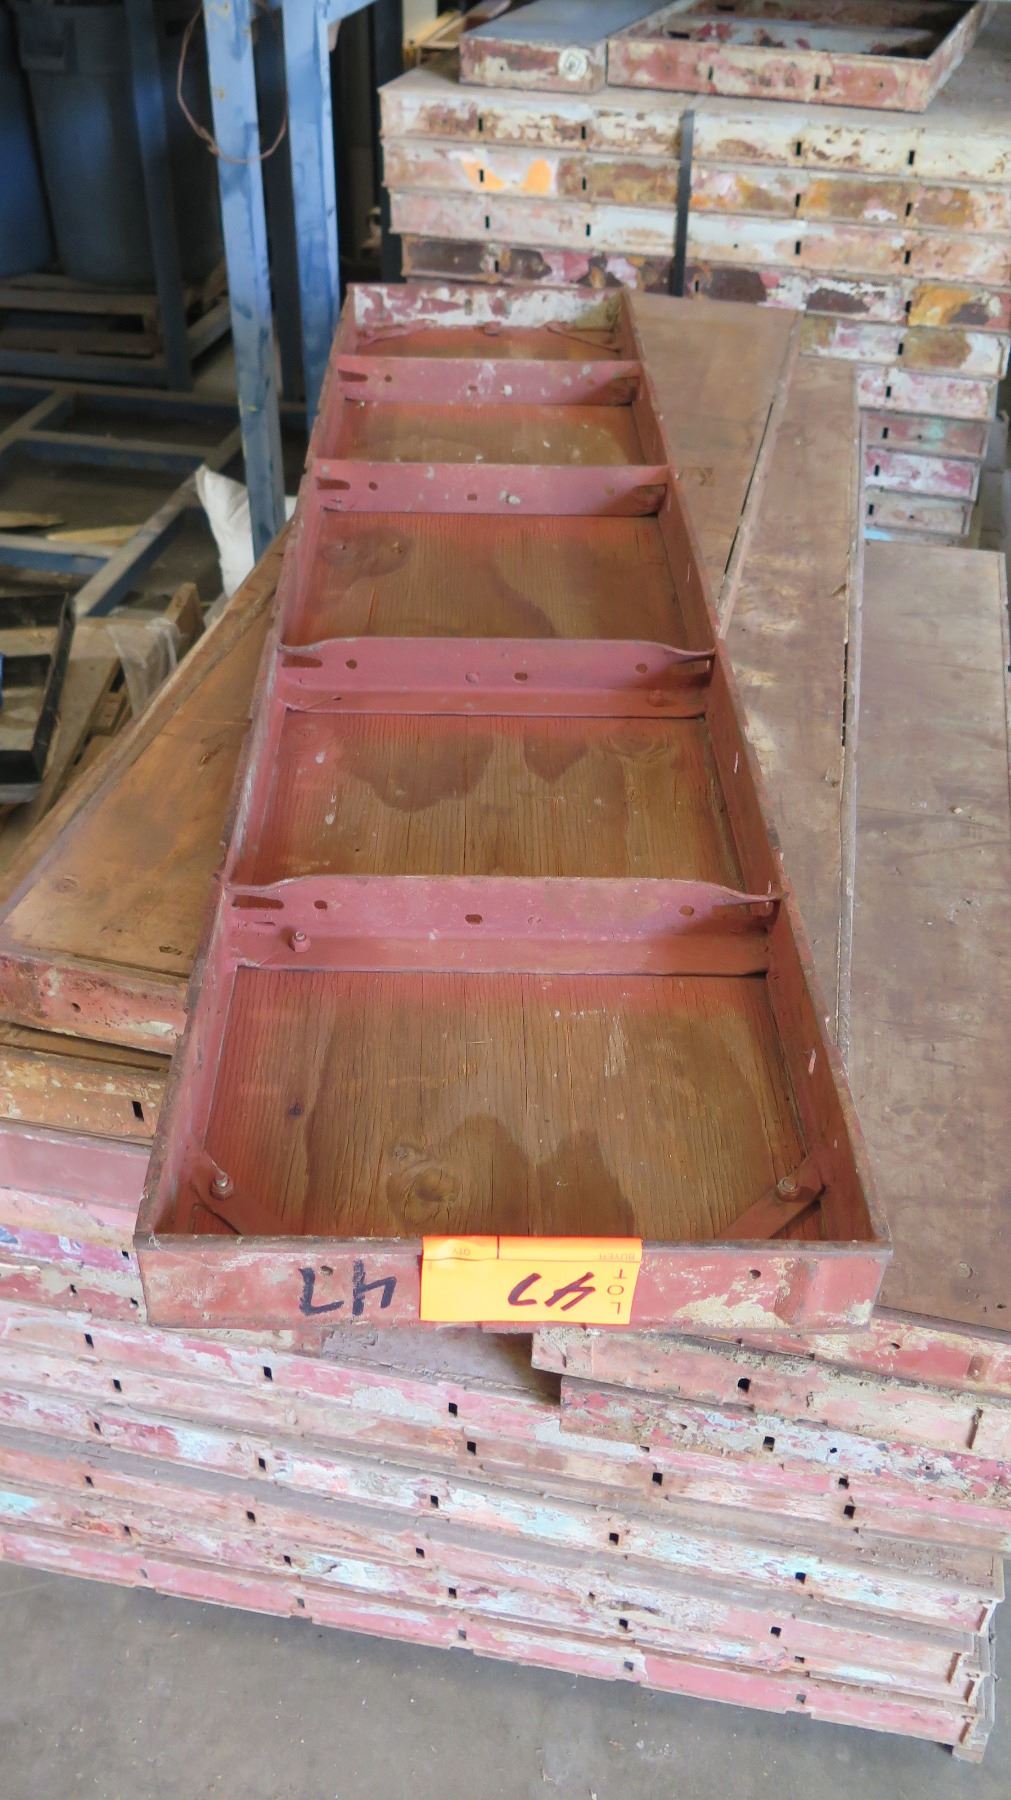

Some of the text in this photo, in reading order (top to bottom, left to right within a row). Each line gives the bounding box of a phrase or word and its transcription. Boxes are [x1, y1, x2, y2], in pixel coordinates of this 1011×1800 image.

[298, 1259, 398, 1316] 47
[507, 1272, 596, 1312] 47
[606, 1268, 627, 1315] LOT
